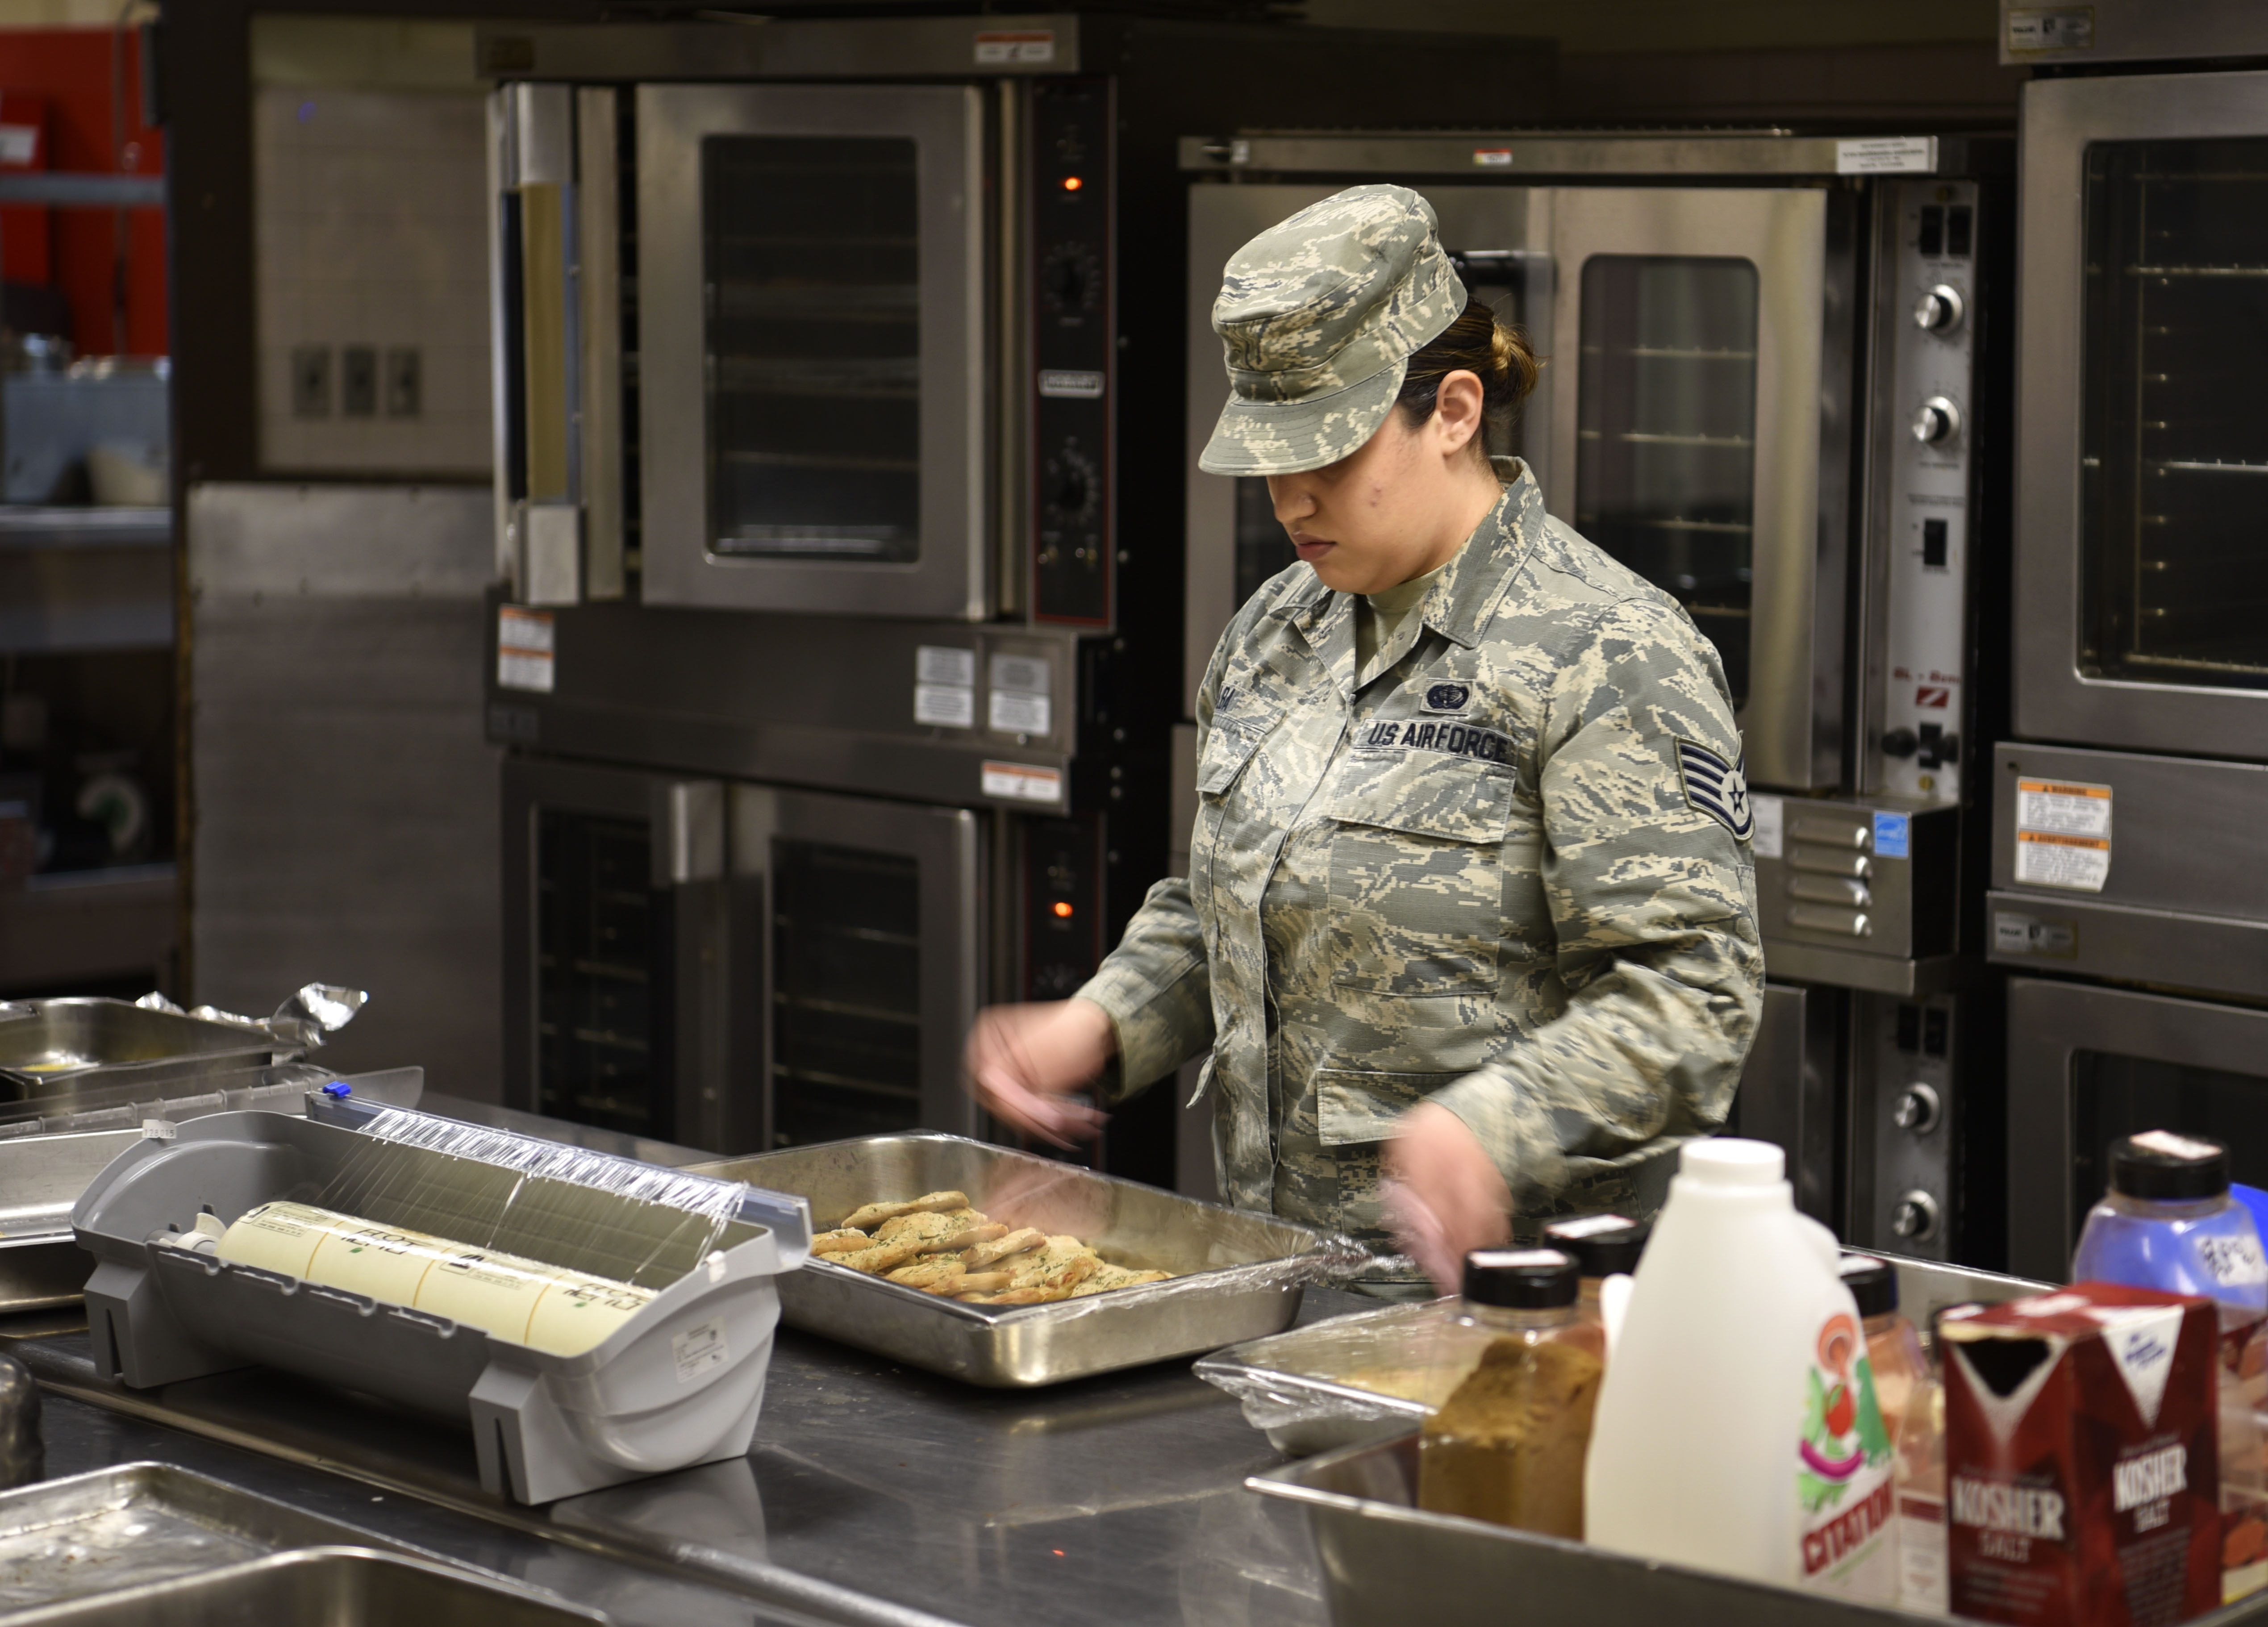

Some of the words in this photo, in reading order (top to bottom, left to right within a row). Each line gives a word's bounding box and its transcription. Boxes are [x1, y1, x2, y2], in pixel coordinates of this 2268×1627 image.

[1400, 723, 1435, 748] AIR
[1434, 723, 1508, 762] FORCE
[1951, 1475, 2066, 1542] KOSHER
[2113, 1443, 2187, 1513] KOSHER
